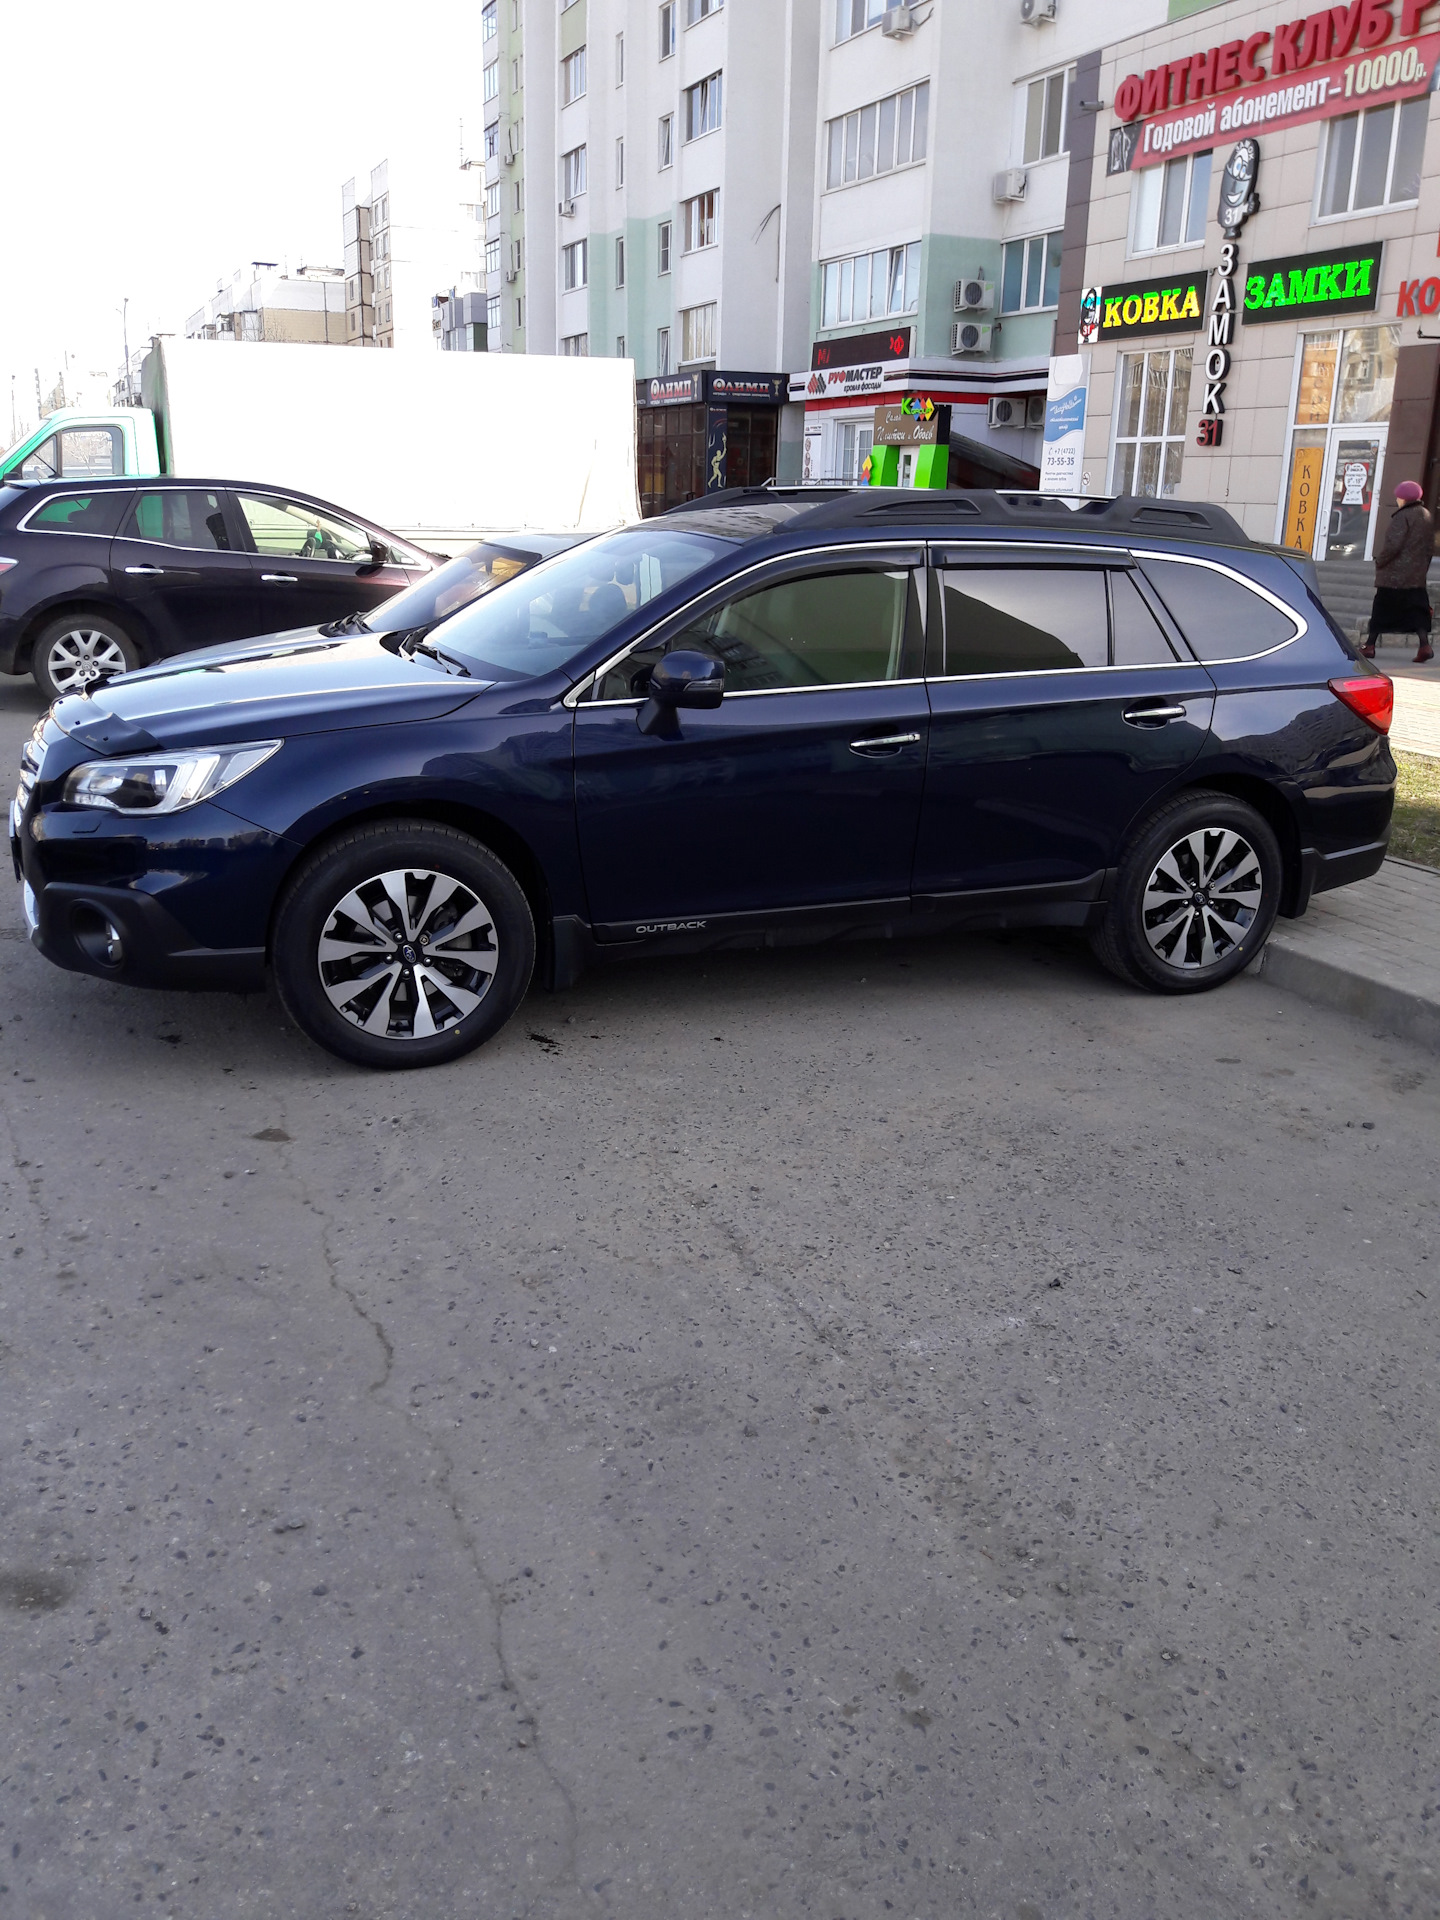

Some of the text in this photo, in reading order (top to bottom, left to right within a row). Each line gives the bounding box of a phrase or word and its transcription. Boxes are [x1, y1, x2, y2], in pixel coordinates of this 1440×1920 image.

[1143, 102, 1216, 153] Годовой
[1224, 208, 1239, 225] 31
[1244, 258, 1374, 309] ЗАМКИ
[1102, 285, 1200, 328] КОВКА
[713, 378, 769, 392] ОЛИМП
[828, 366, 882, 384] РУФМАСТЕР
[651, 379, 691, 400] ОЛИМП
[1196, 418, 1220, 446] 31
[1294, 464, 1311, 549] КОВКА
[635, 920, 707, 933] OUTBACK
